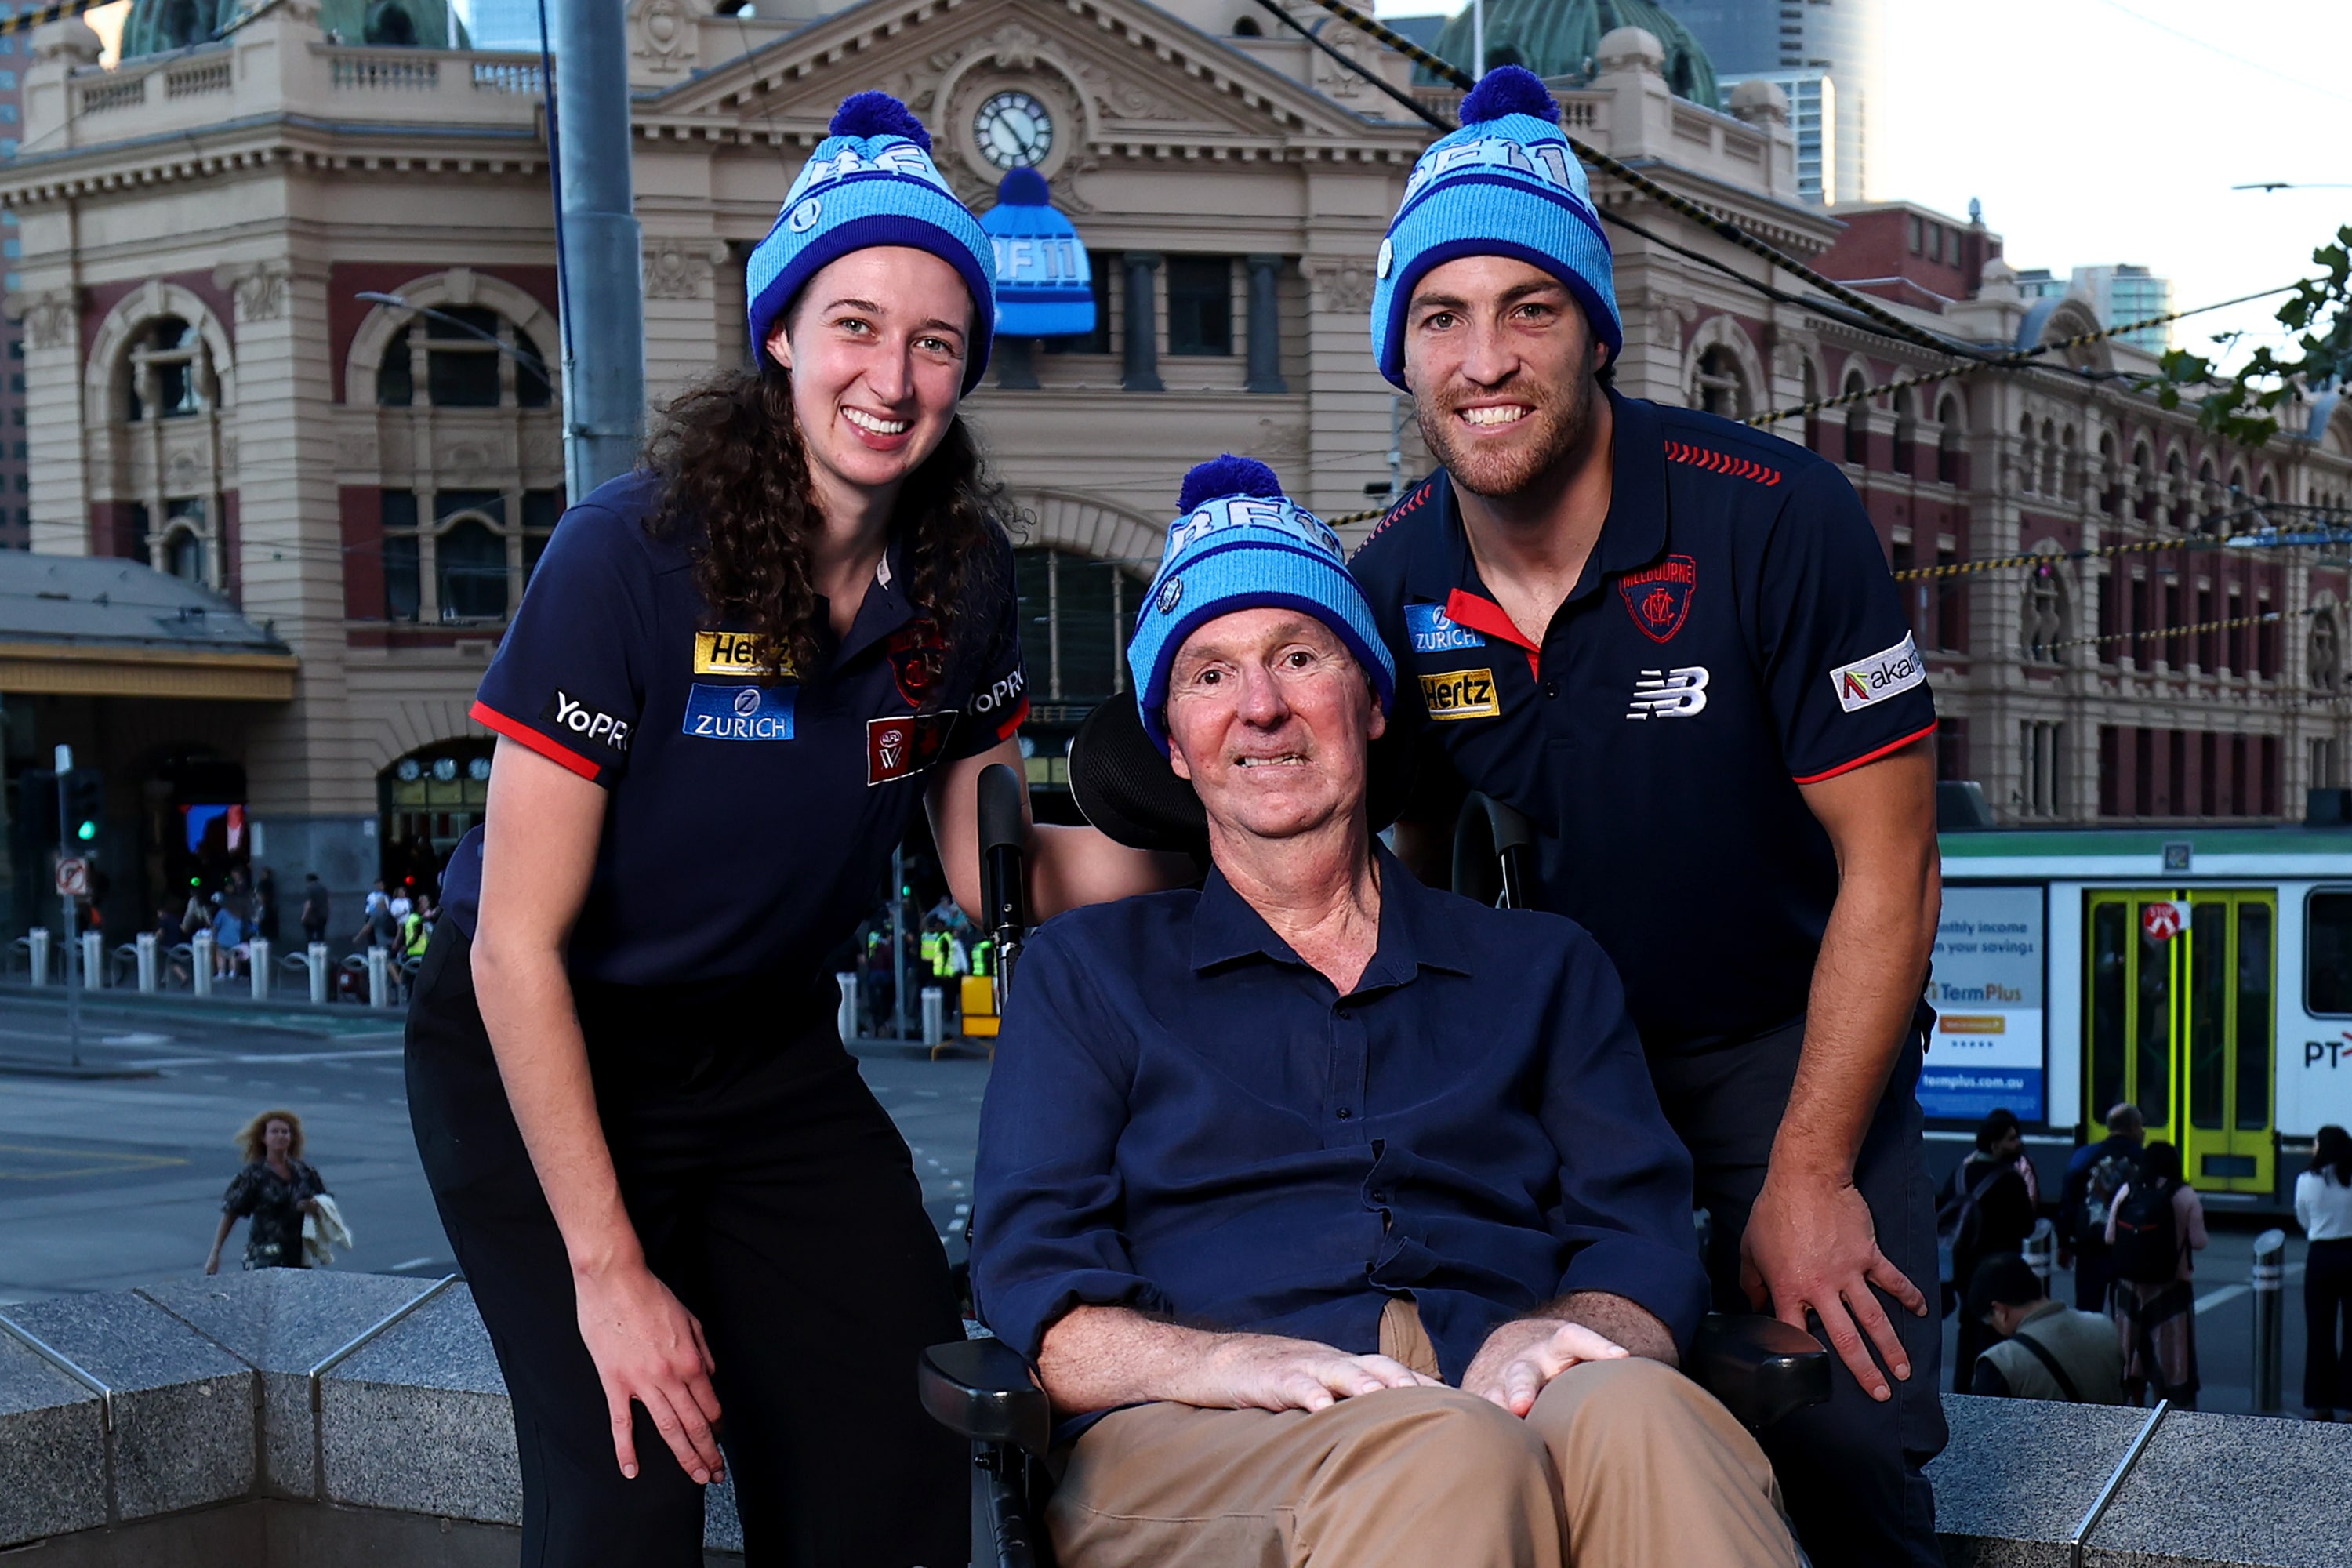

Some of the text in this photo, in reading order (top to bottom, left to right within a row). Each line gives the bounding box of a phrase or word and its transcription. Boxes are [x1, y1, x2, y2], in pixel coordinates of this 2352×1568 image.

[1041, 240, 1077, 278] 11
[710, 634, 789, 664] Hez
[1415, 629, 1476, 650] ZURICH
[1422, 675, 1491, 710] Hertz
[695, 714, 786, 739] ZURICH
[1939, 920, 2028, 937] nthly income
[1947, 942, 1978, 954] your
[1982, 940, 2034, 956] savings
[1941, 983, 2022, 1001] TermPlus
[1923, 1075, 2024, 1090] termplus.com.au
